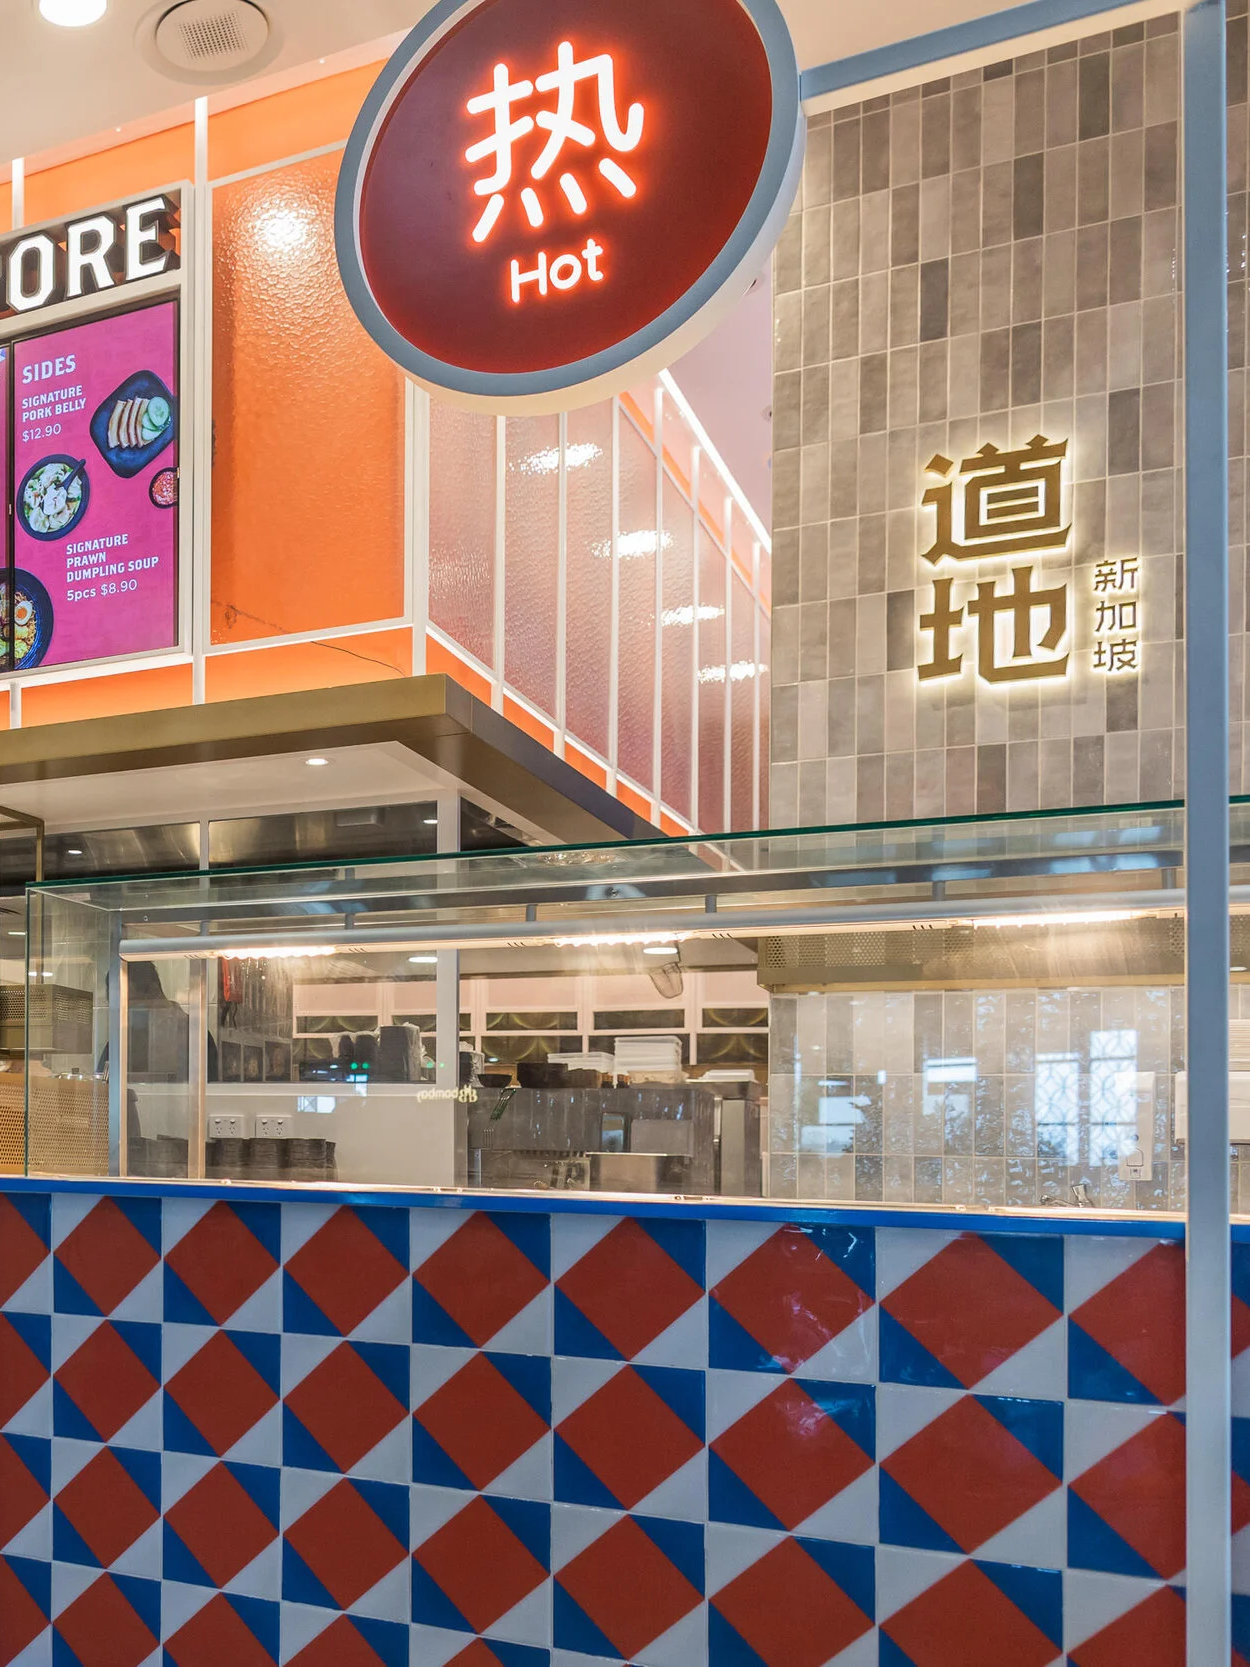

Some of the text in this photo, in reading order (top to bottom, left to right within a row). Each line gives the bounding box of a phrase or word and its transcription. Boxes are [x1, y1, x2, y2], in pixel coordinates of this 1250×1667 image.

[465, 41, 644, 242] 热
[510, 239, 603, 303] Hot
[22, 354, 76, 384] SIDES
[22, 385, 83, 409] SIGNATURE
[22, 398, 86, 422] PORK BELLY
[22, 423, 62, 443] $12.90
[66, 534, 129, 555] SIGNATURE
[66, 552, 107, 568] PRAWN
[66, 556, 159, 582] DUMPLING SOUP
[917, 434, 1072, 684] 道地
[67, 579, 138, 602] 5pcs $8.90
[1093, 557, 1139, 671] 新加坡
